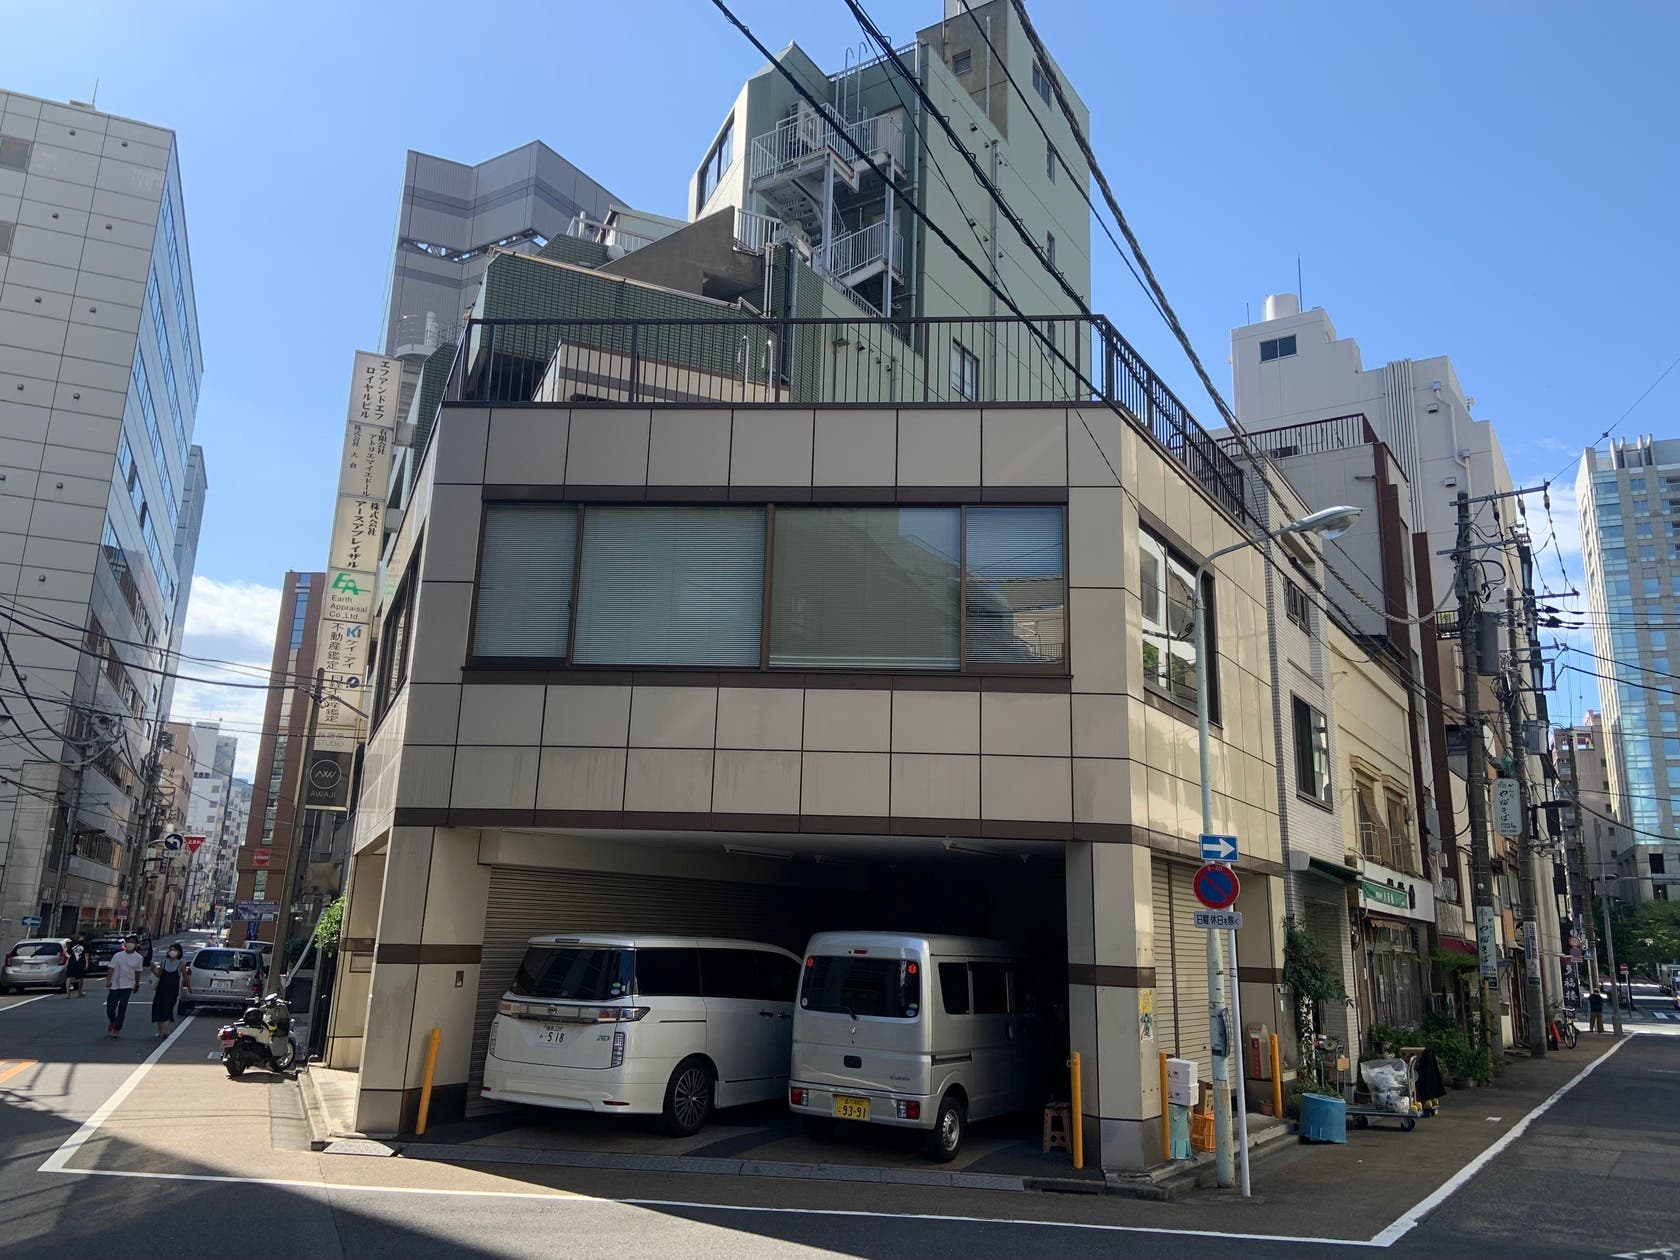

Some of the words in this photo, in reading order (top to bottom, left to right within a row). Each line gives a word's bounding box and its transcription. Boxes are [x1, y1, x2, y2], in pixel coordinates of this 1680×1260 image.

[360, 367, 376, 418] ロイヤルビル
[374, 361, 390, 420] エフアンドエフ
[331, 594, 353, 603] Earth
[330, 602, 368, 613] Appraisal
[842, 1105, 866, 1119] 93-91
